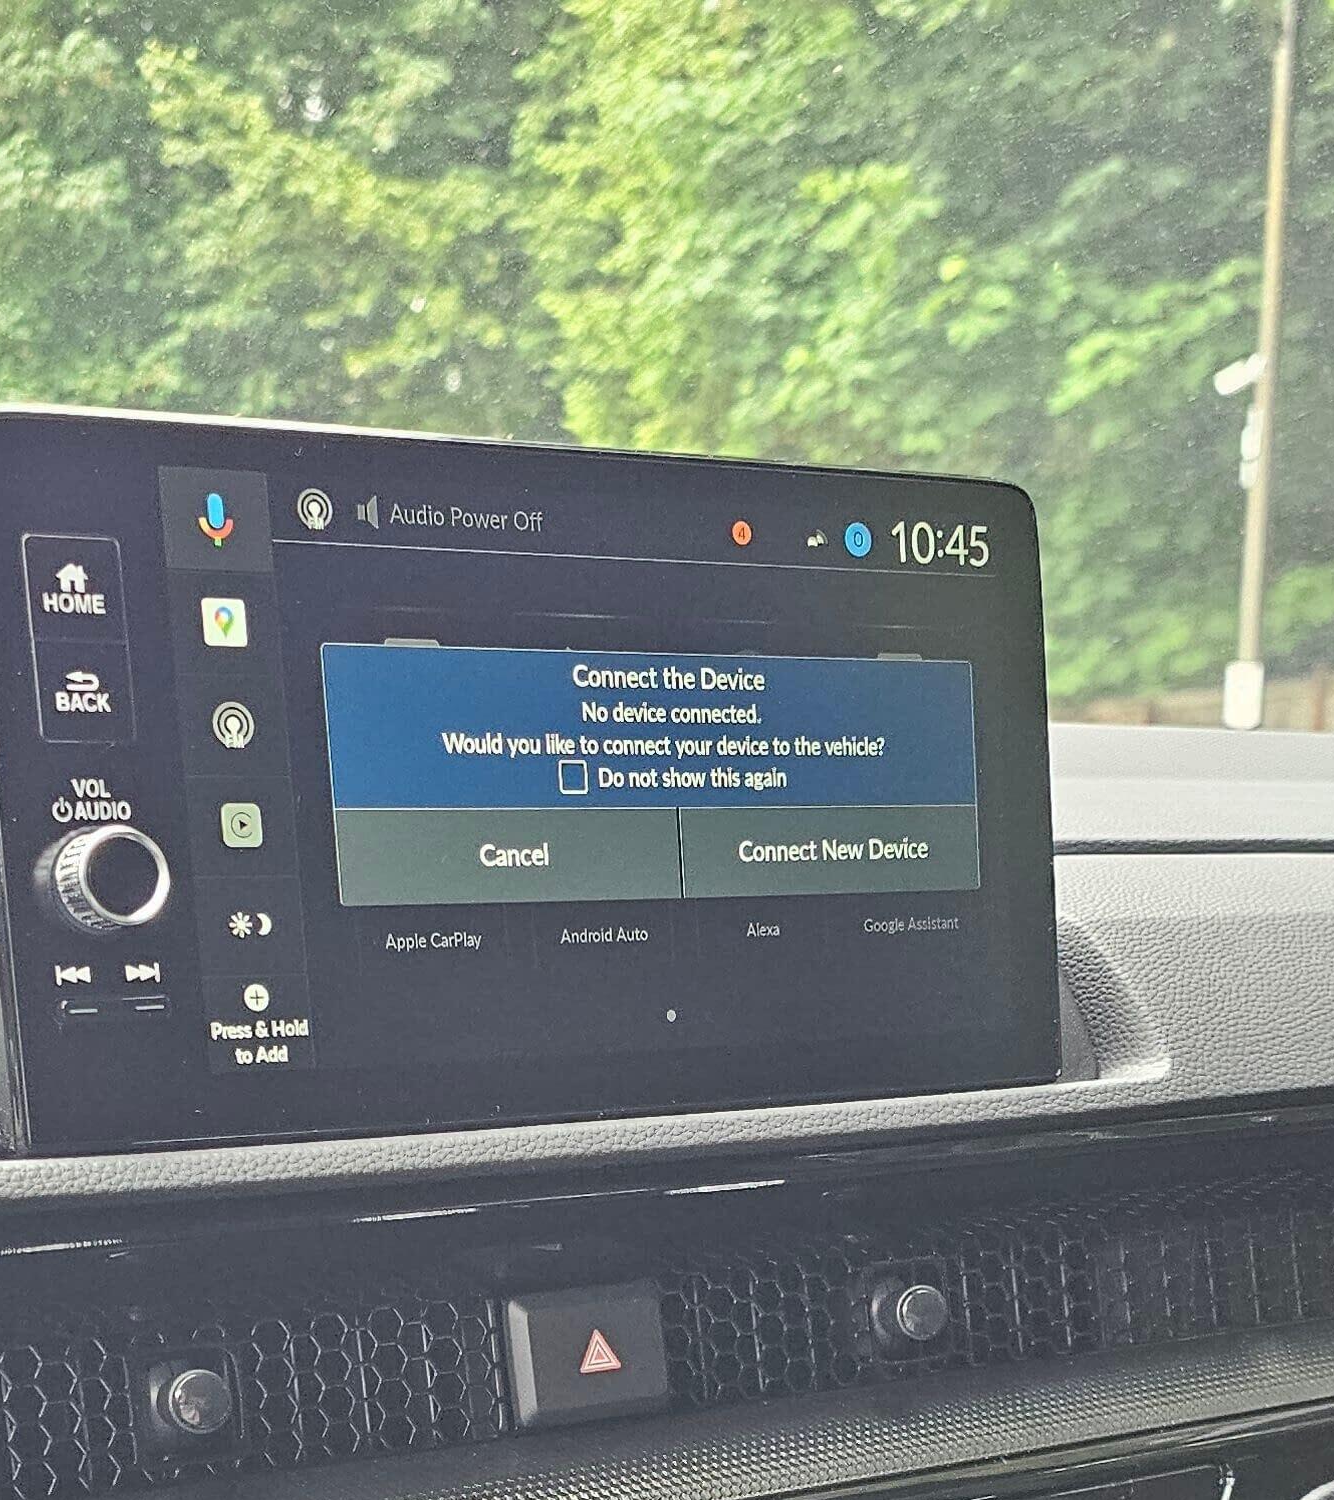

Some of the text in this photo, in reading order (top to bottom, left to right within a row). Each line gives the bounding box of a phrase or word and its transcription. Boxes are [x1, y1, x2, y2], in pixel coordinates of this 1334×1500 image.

[390, 503, 544, 532] Audio Power Off
[890, 520, 990, 568] 10:45
[42, 593, 107, 615] HOME
[572, 664, 766, 692] Connect the Device
[54, 691, 112, 713] BACK
[581, 702, 763, 725] No device connected.
[441, 732, 885, 759] Would you like to connect your device to the vehicle?
[70, 778, 112, 799] VOL
[597, 767, 788, 791] Do not show this again
[74, 800, 132, 821] AUDIO
[479, 842, 550, 868] Cancel
[737, 837, 930, 863] Connect New Device
[560, 926, 649, 945] Android Auto
[746, 922, 780, 938] Alexa
[863, 915, 960, 936] Google Assistant
[385, 930, 482, 952] Apple CarPlay
[209, 1018, 310, 1041] Press & Hold
[234, 1045, 289, 1065] to Add
